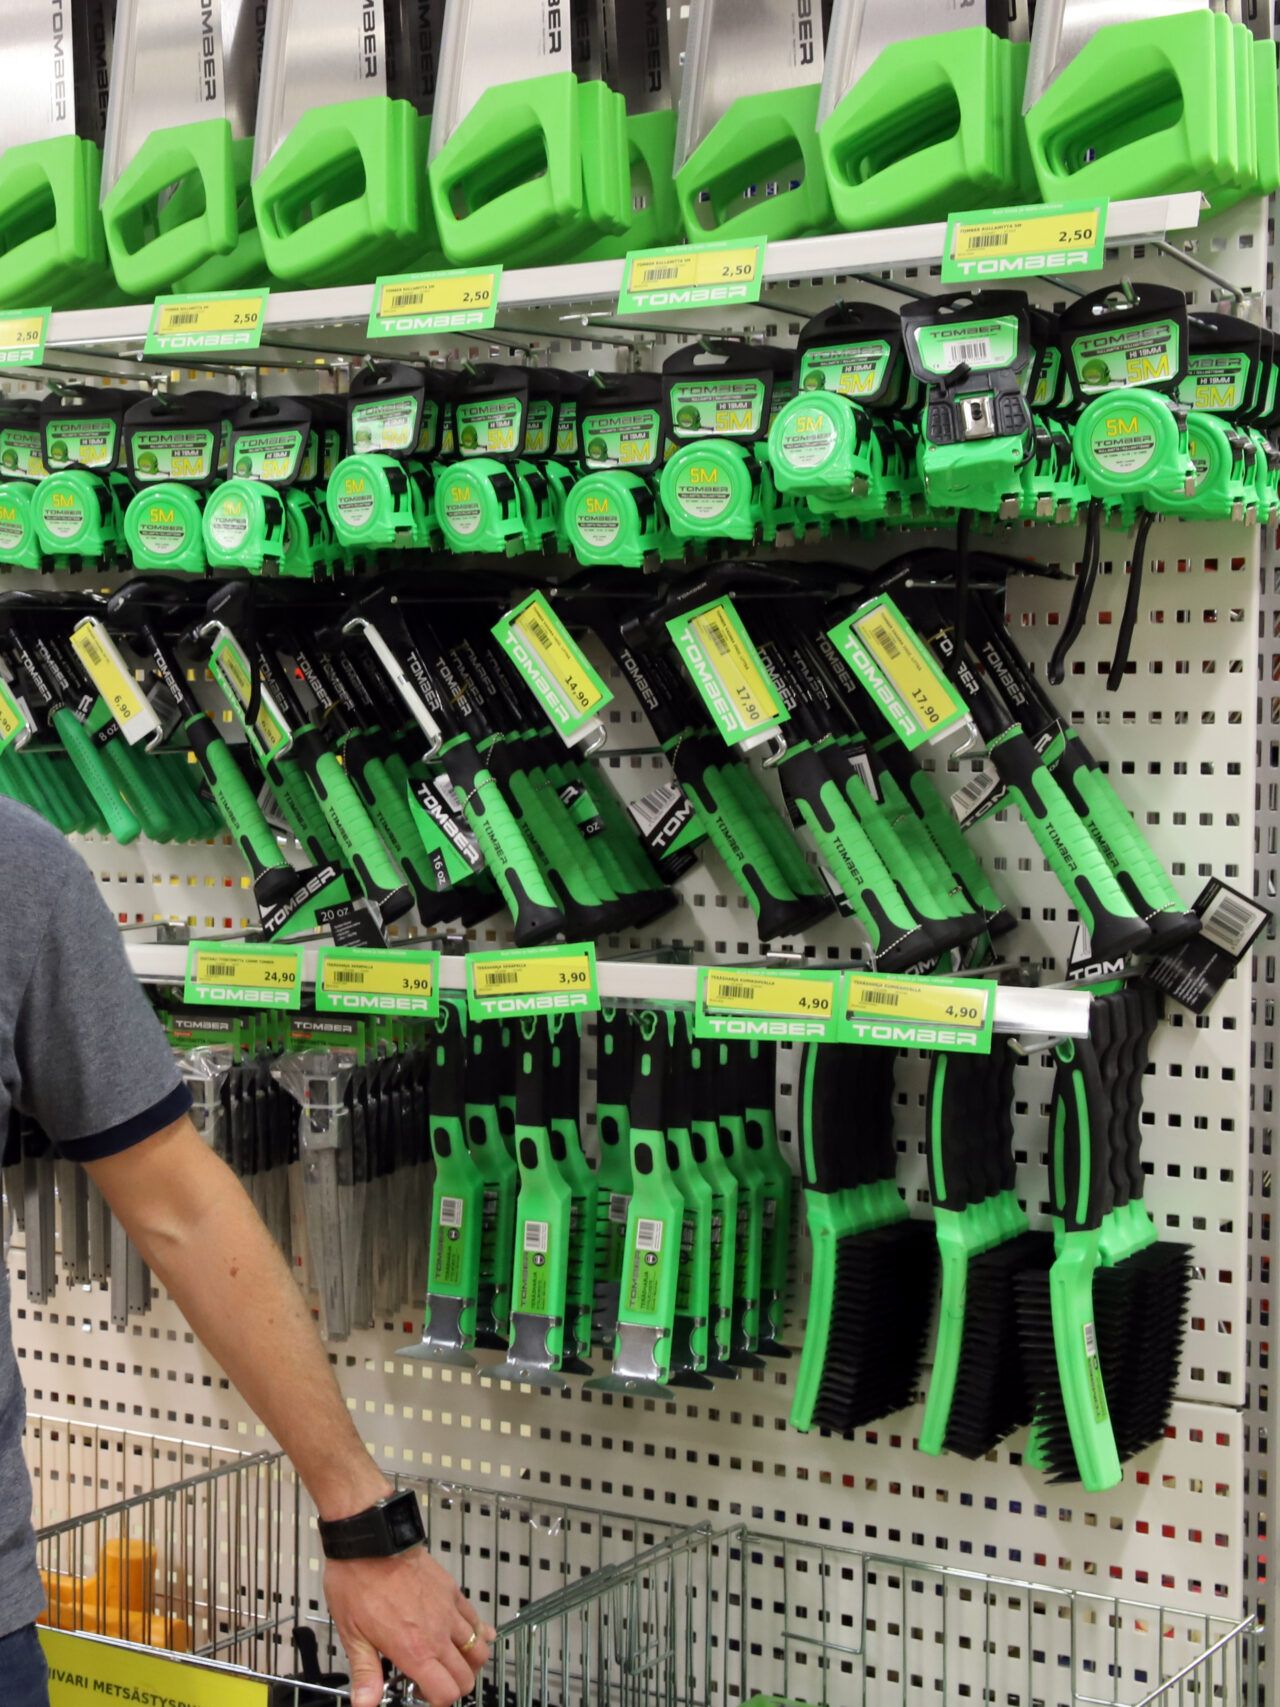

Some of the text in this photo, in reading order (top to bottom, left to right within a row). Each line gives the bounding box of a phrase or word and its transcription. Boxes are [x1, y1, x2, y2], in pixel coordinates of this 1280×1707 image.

[1058, 229, 1092, 243] 2,50
[722, 264, 752, 277] 2,50
[957, 251, 1088, 275] TOMBER
[463, 290, 489, 302] 2,50
[632, 285, 747, 307] TOMBER
[233, 313, 258, 323] 2,50
[381, 312, 483, 331] TOMBER
[16, 331, 38, 342] 2,50
[157, 333, 250, 348] TOMBER
[1079, 325, 1170, 350] TOMBER
[1127, 355, 1169, 383] 5M
[1188, 357, 1241, 369] MBER
[677, 384, 757, 395] TOMBER
[839, 371, 875, 394] 5M
[1196, 386, 1235, 408] 5M
[716, 410, 752, 431] 5M
[797, 415, 823, 433] 5M
[1106, 416, 1138, 437] 5M
[382, 427, 408, 446] 5M
[488, 427, 514, 449] 5M
[1095, 435, 1152, 446] TOMBER
[79, 446, 106, 464] 5M
[620, 441, 650, 462] 5M
[171, 458, 204, 477] 5M
[261, 460, 290, 479] 5M
[690, 468, 718, 484] 5M
[345, 478, 365, 494] 5M
[451, 487, 471, 502] 5M
[52, 494, 74, 508] 5M
[586, 497, 609, 513] 5M
[150, 508, 174, 523] 5M
[36, 638, 69, 690] TOMBER
[981, 642, 1026, 705] TOMBER
[21, 651, 52, 702] TOMBER
[153, 649, 183, 704] TOMBER
[297, 651, 333, 709] TOMBER
[407, 651, 440, 712] TOMBER
[436, 656, 472, 717] TOMBER
[505, 631, 569, 724] TOMBER
[621, 649, 658, 710] TOMBER
[680, 628, 738, 732] TOMBER
[758, 648, 797, 711] TOMBER
[844, 634, 917, 736] TOMBER
[565, 675, 589, 708] 14,90
[114, 695, 131, 718] 6,90
[736, 685, 760, 721] 17,90
[911, 687, 940, 725] 17,90
[99, 732, 108, 741] 8
[417, 782, 480, 865] TOMBER
[651, 798, 694, 847] TOM
[716, 816, 744, 861] TOMBER
[1045, 822, 1078, 873] TOMBER
[1089, 820, 1120, 868] TOMBER
[432, 855, 441, 869] 16
[832, 836, 864, 886] TOMBER
[264, 866, 336, 932] TOMBER
[321, 910, 334, 922] 20
[264, 971, 296, 983] 24,90
[559, 972, 586, 984] 3,90
[1069, 957, 1124, 981] TOM
[402, 978, 428, 991] 3,90
[195, 987, 290, 1004] TOMBER
[328, 994, 428, 1011] TOMBER
[481, 994, 588, 1013] TOMBER
[798, 997, 829, 1010] 4,90
[946, 1005, 978, 1019] 4,90
[175, 1019, 229, 1030] TOMBER
[294, 1020, 353, 1033] TOMBER
[709, 1020, 825, 1036] TOMBER
[852, 1024, 977, 1046] TOMBER
[93, 1679, 205, 1707] METSÄSTYSP
